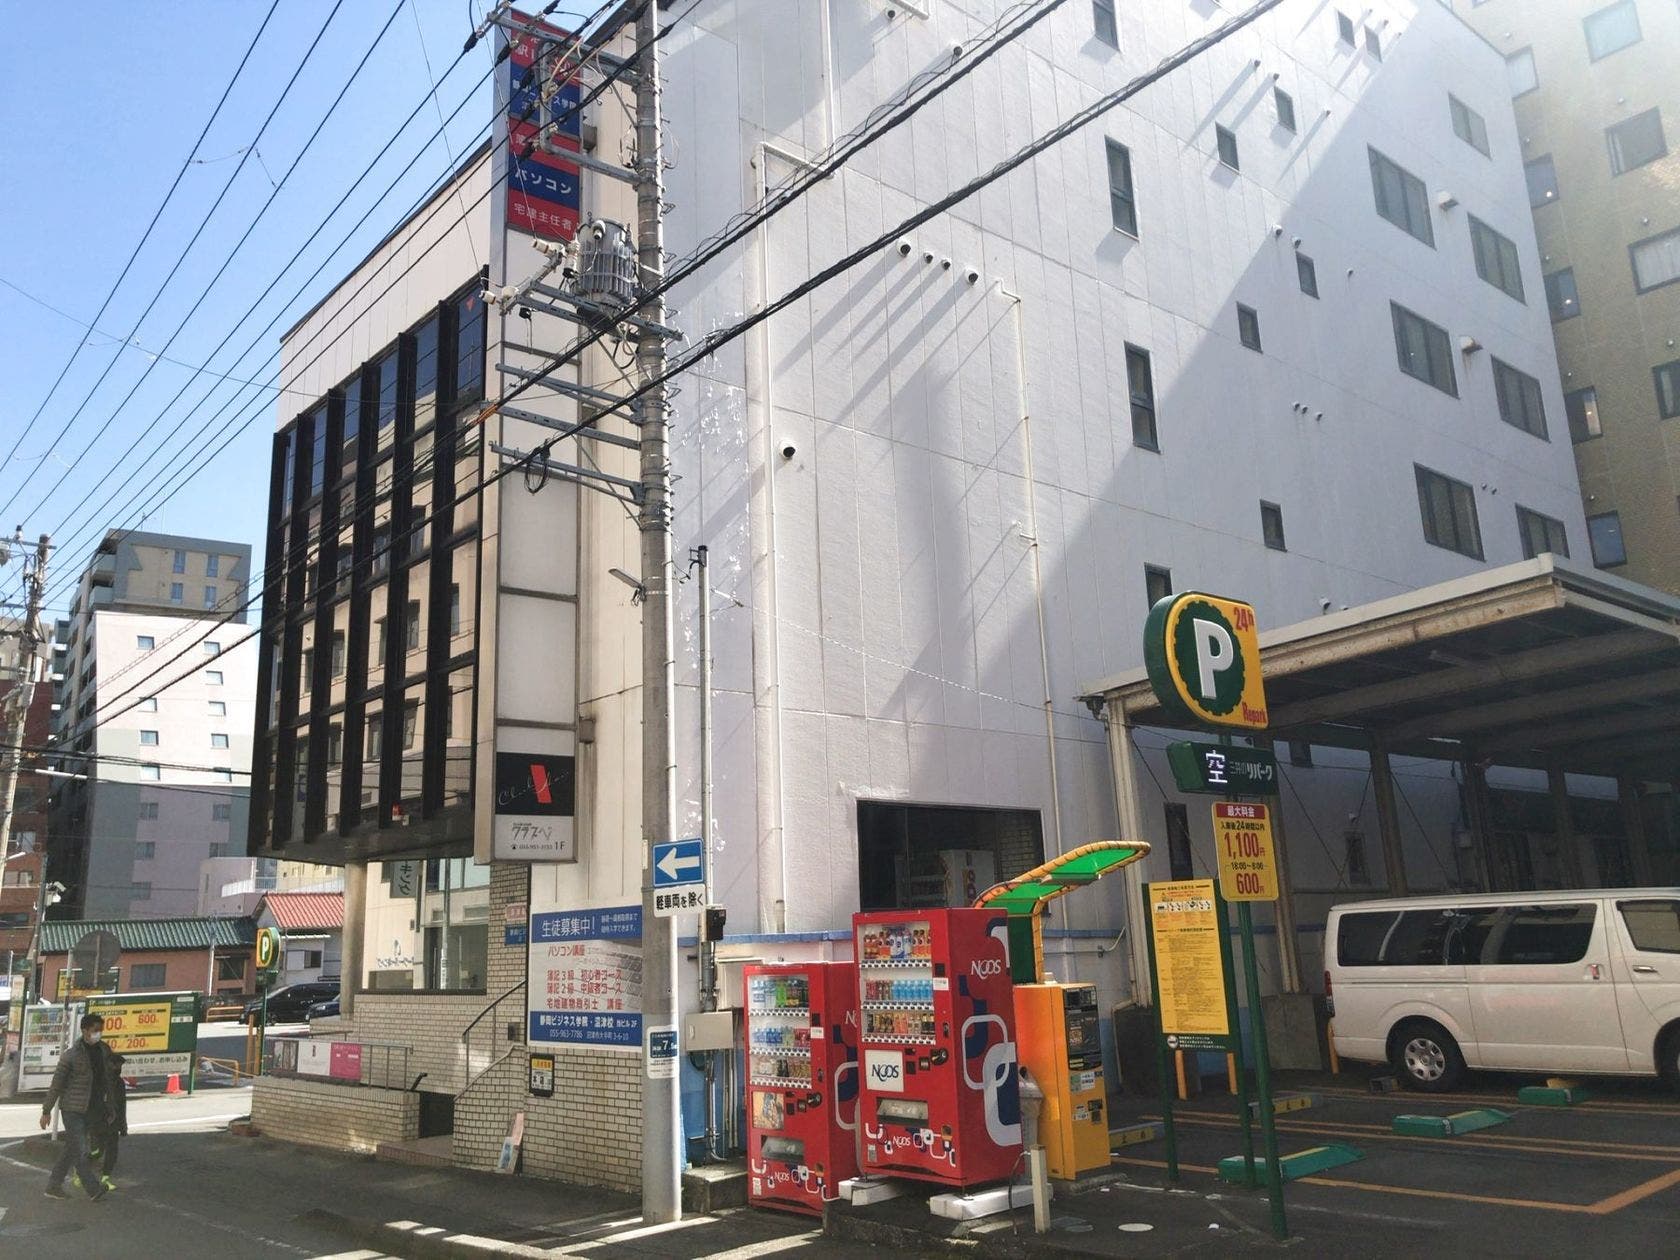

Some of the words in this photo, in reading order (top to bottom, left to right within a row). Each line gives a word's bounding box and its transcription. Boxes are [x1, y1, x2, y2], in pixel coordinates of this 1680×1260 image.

[1193, 618, 1234, 700] P
[1205, 750, 1228, 784] 空
[1227, 805, 1256, 818] 最大料金
[656, 892, 704, 911] 軽車両を除く
[261, 936, 270, 961] P
